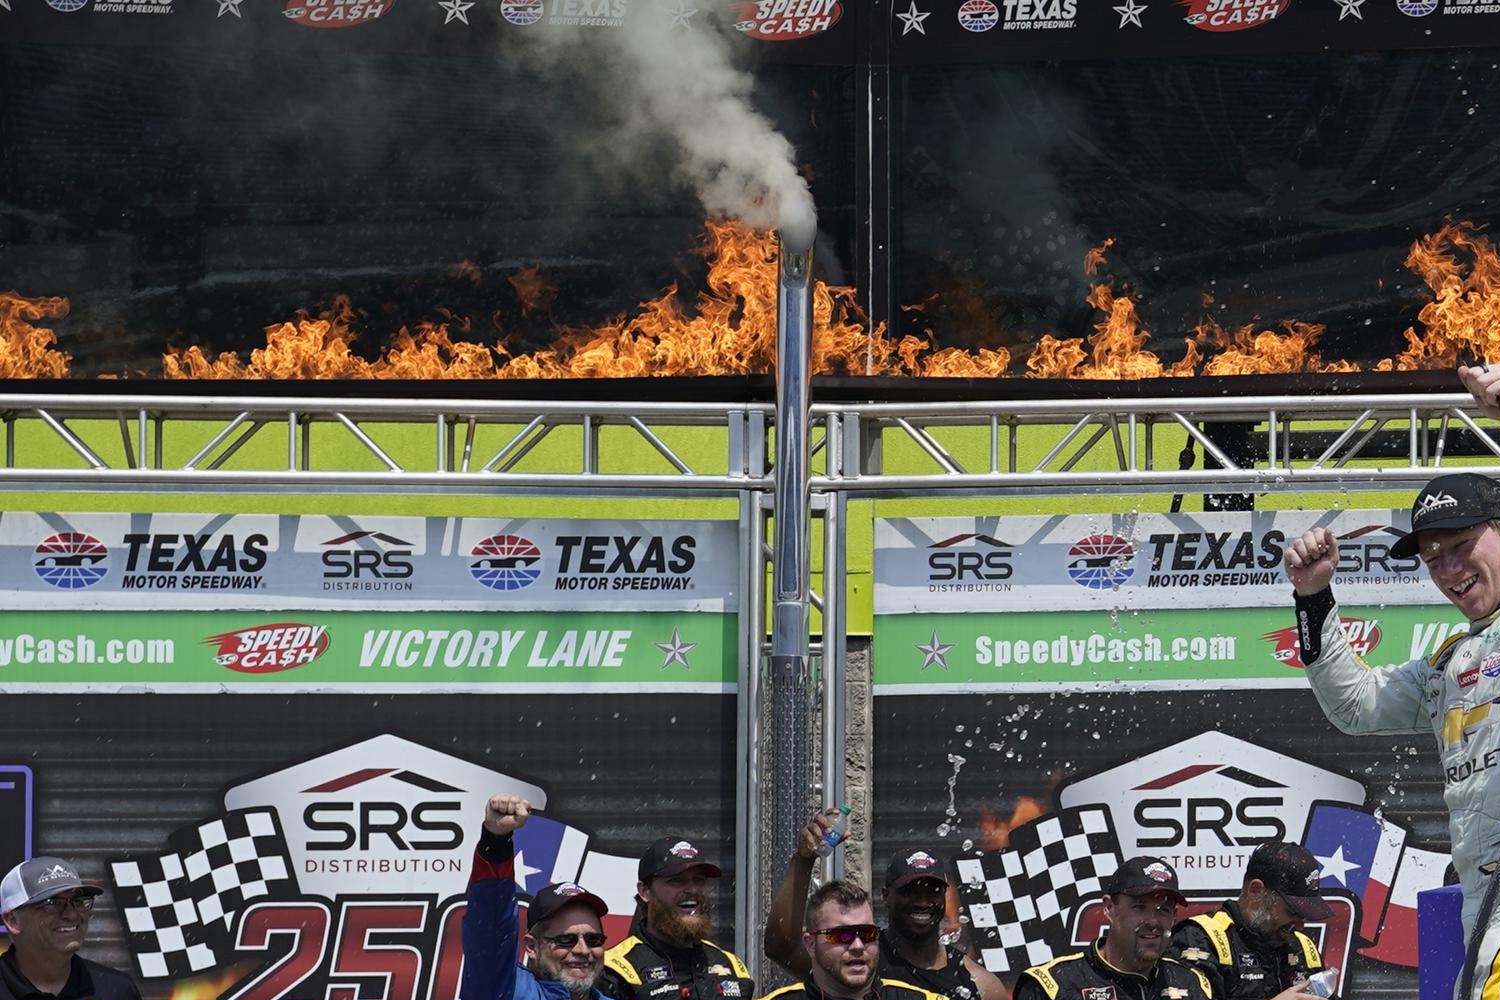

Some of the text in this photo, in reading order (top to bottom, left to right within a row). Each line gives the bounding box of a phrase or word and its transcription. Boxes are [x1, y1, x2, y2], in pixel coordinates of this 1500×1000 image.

[94, 3, 171, 14] MOTOR SPEEDWAY
[756, 0, 836, 20] SPEEDY
[1003, 0, 1077, 21] TEXAS
[1443, 5, 1472, 14] MOTOR
[759, 17, 830, 34] CA$H
[1003, 21, 1074, 30] MOTOR SPEEDWAY
[123, 534, 268, 572] TEXAS
[556, 535, 696, 574] TEXAS
[1149, 531, 1285, 571] TEXAS
[1337, 544, 1420, 572] SRS
[322, 549, 413, 578] SRS
[929, 553, 1012, 580] SRS
[122, 575, 263, 591] MOTOR SPEEDWAY
[323, 582, 413, 591] DISTRIBUTION
[555, 576, 690, 591] MOTOR SPEEDWAY
[929, 584, 1012, 592] DISTRIBUTION
[1148, 573, 1279, 588] MOTOR SPEEDWAY
[1336, 576, 1419, 585] DISTRIBUTION
[238, 625, 328, 652] SPEEDY
[360, 630, 631, 667] VICTORY LANE
[241, 650, 318, 667] CA$H
[975, 633, 1236, 666] SpeedyCash.com
[303, 802, 464, 851] SRS
[1133, 797, 1286, 847] SRS
[305, 859, 461, 873] DISTRIBUTION
